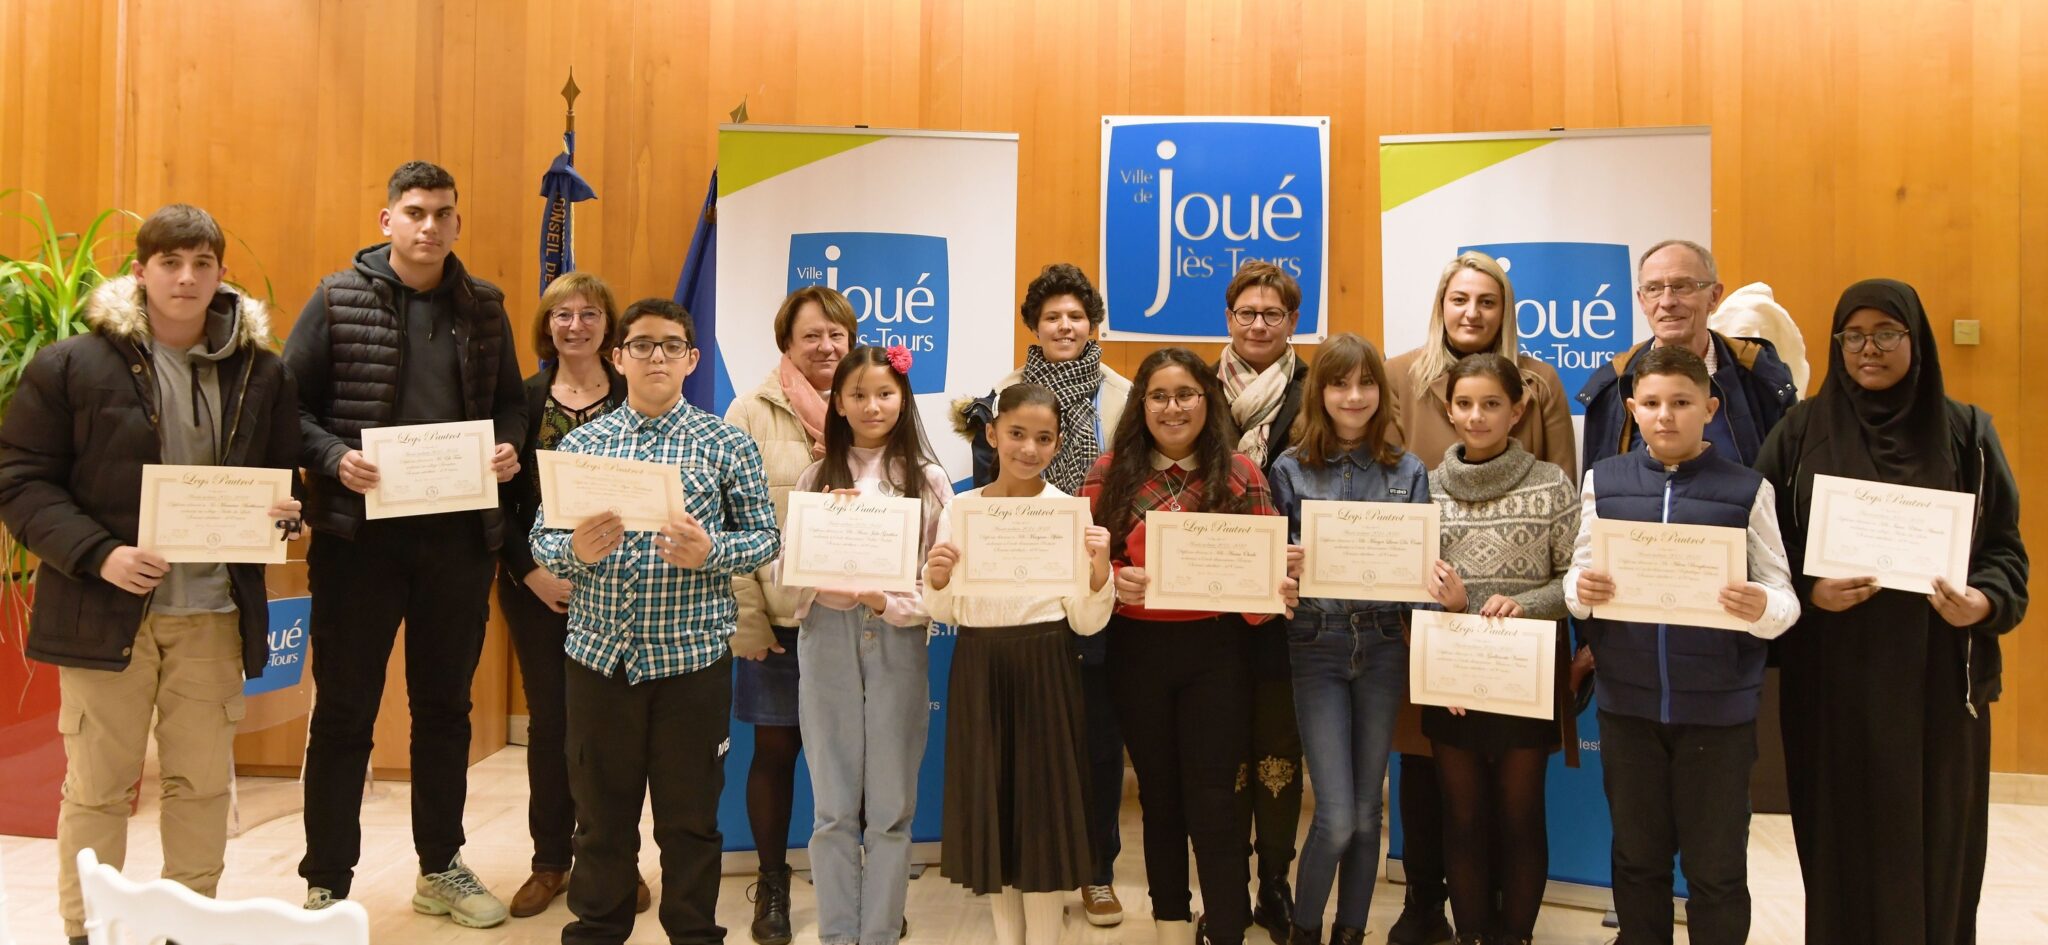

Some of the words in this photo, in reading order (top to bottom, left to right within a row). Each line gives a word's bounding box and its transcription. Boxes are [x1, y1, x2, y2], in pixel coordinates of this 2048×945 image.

[1120, 169, 1153, 184] Ville
[1133, 188, 1153, 203] de
[546, 201, 565, 257] ONSEIL
[797, 266, 823, 280] Ville
[267, 618, 302, 651] ué
